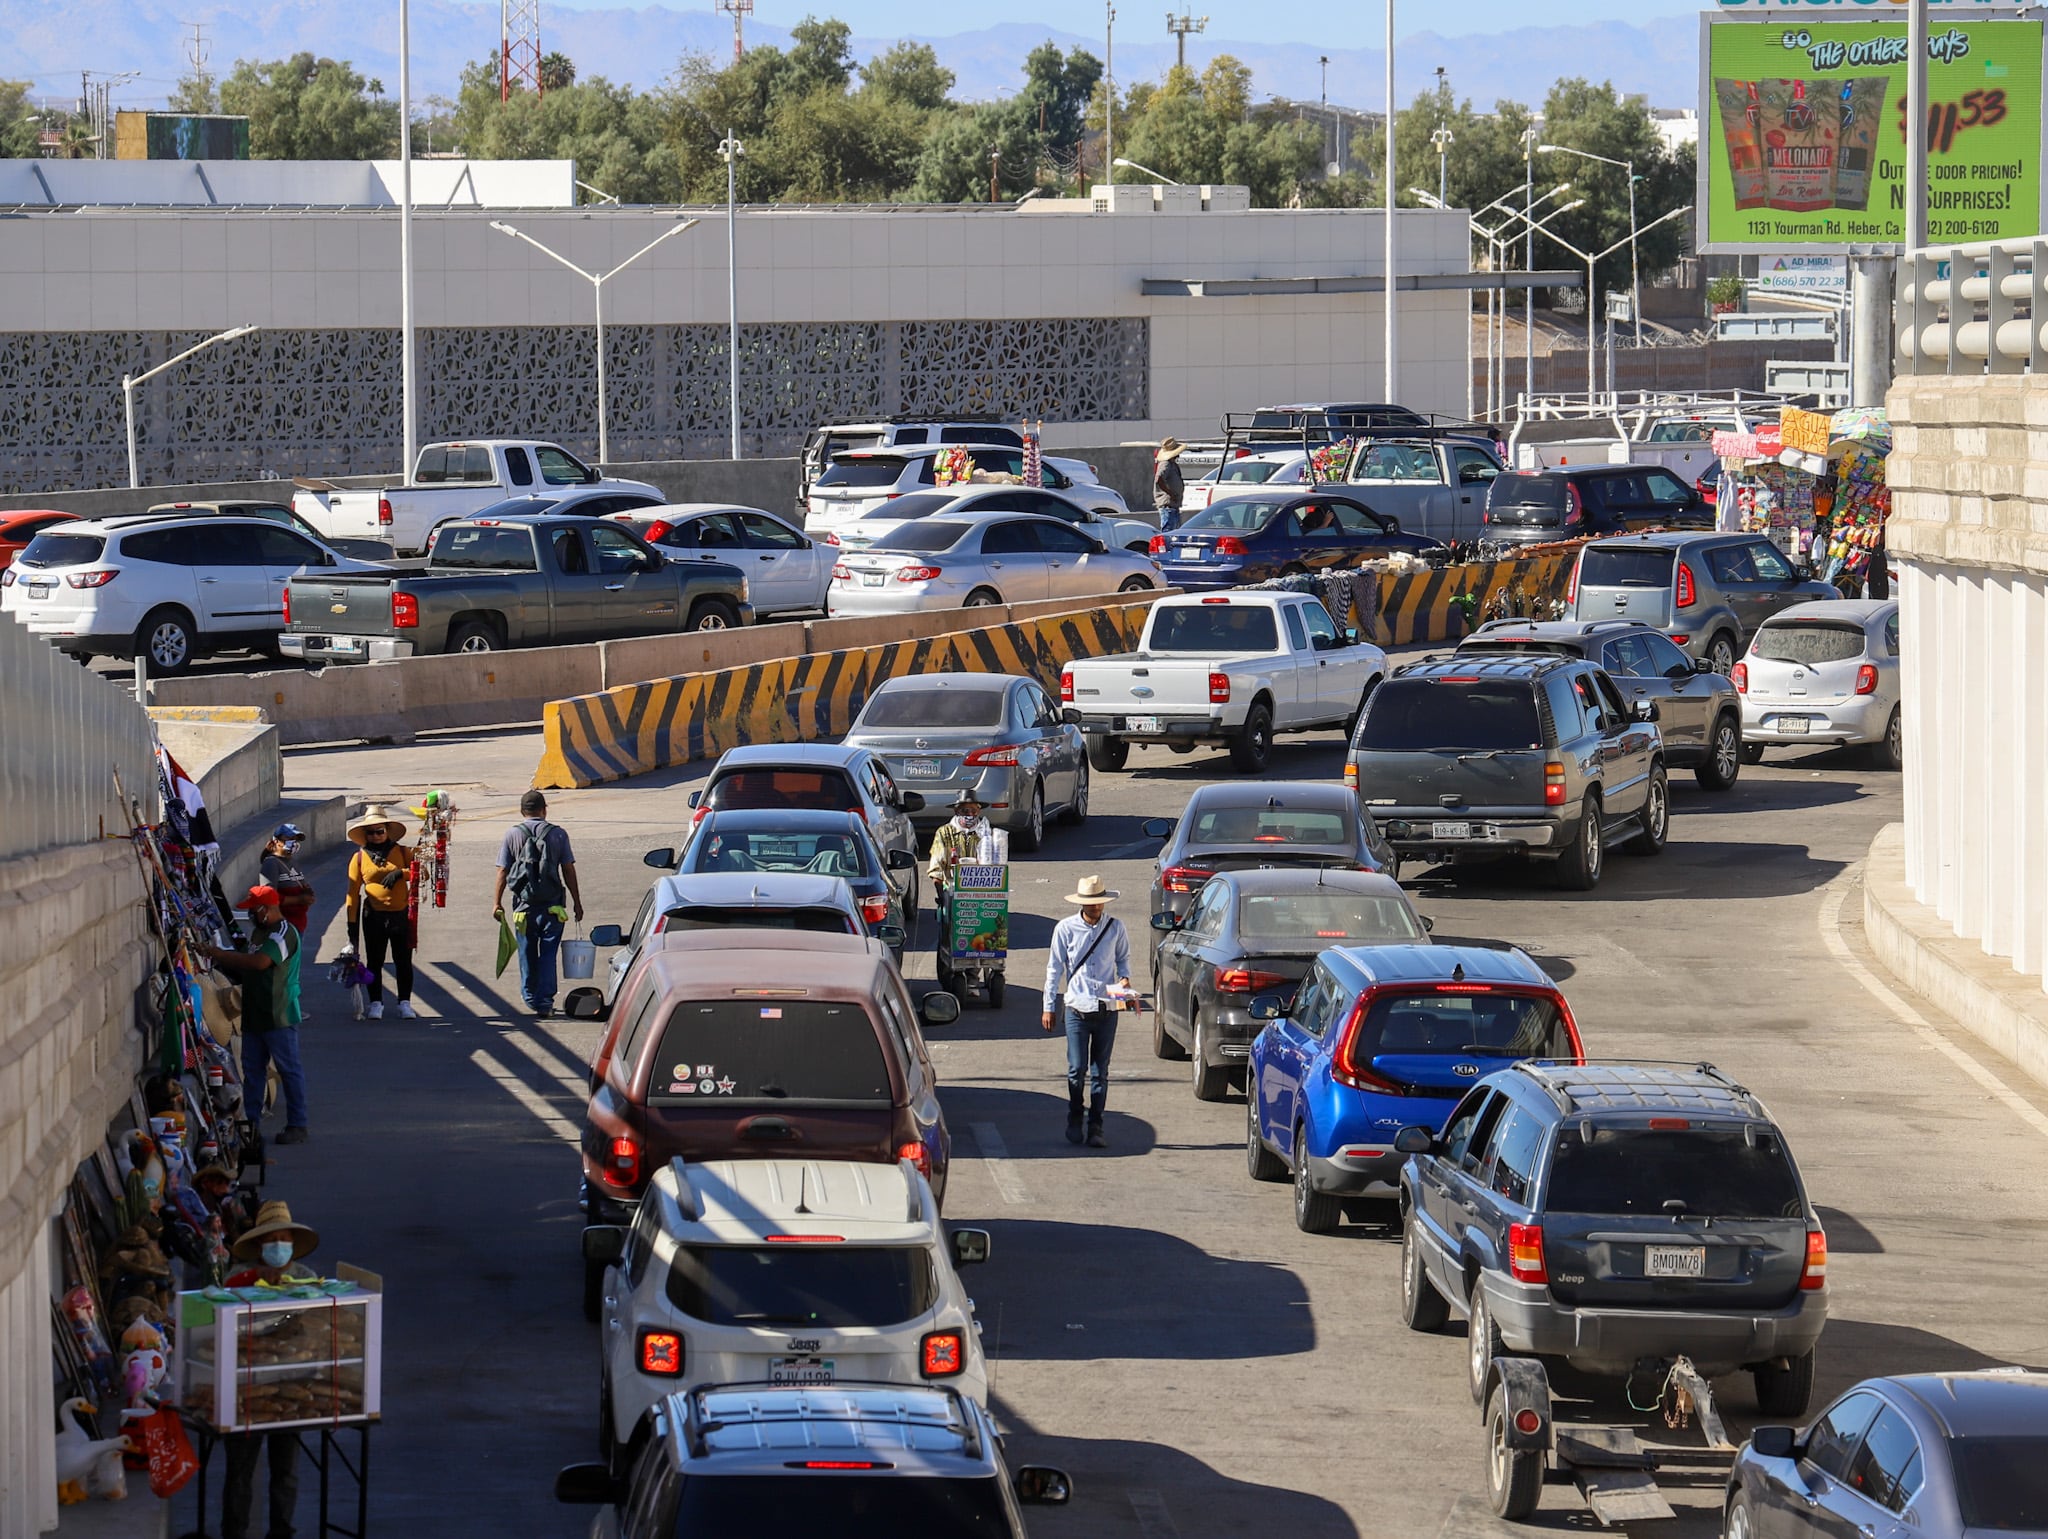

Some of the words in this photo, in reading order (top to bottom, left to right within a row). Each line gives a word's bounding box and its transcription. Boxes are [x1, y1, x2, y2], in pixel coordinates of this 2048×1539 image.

[1807, 39, 1847, 71] THE
[1848, 35, 1908, 66] OTHER
[1774, 147, 1831, 166] MELONADE
[1936, 165, 1967, 180] DOOR
[1971, 159, 2022, 180] PRICING!
[1748, 220, 1771, 235] 1131
[1774, 220, 1823, 235] Yourman
[1826, 220, 1844, 235] Rd.
[1848, 220, 1882, 236] Heber,
[1885, 220, 1900, 235] Ca
[1945, 220, 1999, 235] 200-6120
[1772, 275, 1798, 287] (686)
[1799, 276, 1816, 286] 570
[1818, 276, 1830, 286] 22
[1832, 276, 1845, 286] 38
[1782, 410, 1829, 437] AGUA
[1783, 428, 1828, 454] SODAS
[960, 866, 990, 877] NIEVES
[991, 866, 1003, 877] DE
[961, 877, 1002, 888] GARRAFA
[1457, 1065, 1475, 1074] KIA
[1652, 1253, 1700, 1270] BM01M78
[1558, 1273, 1585, 1284] Jeep
[787, 1337, 822, 1352] Jeep
